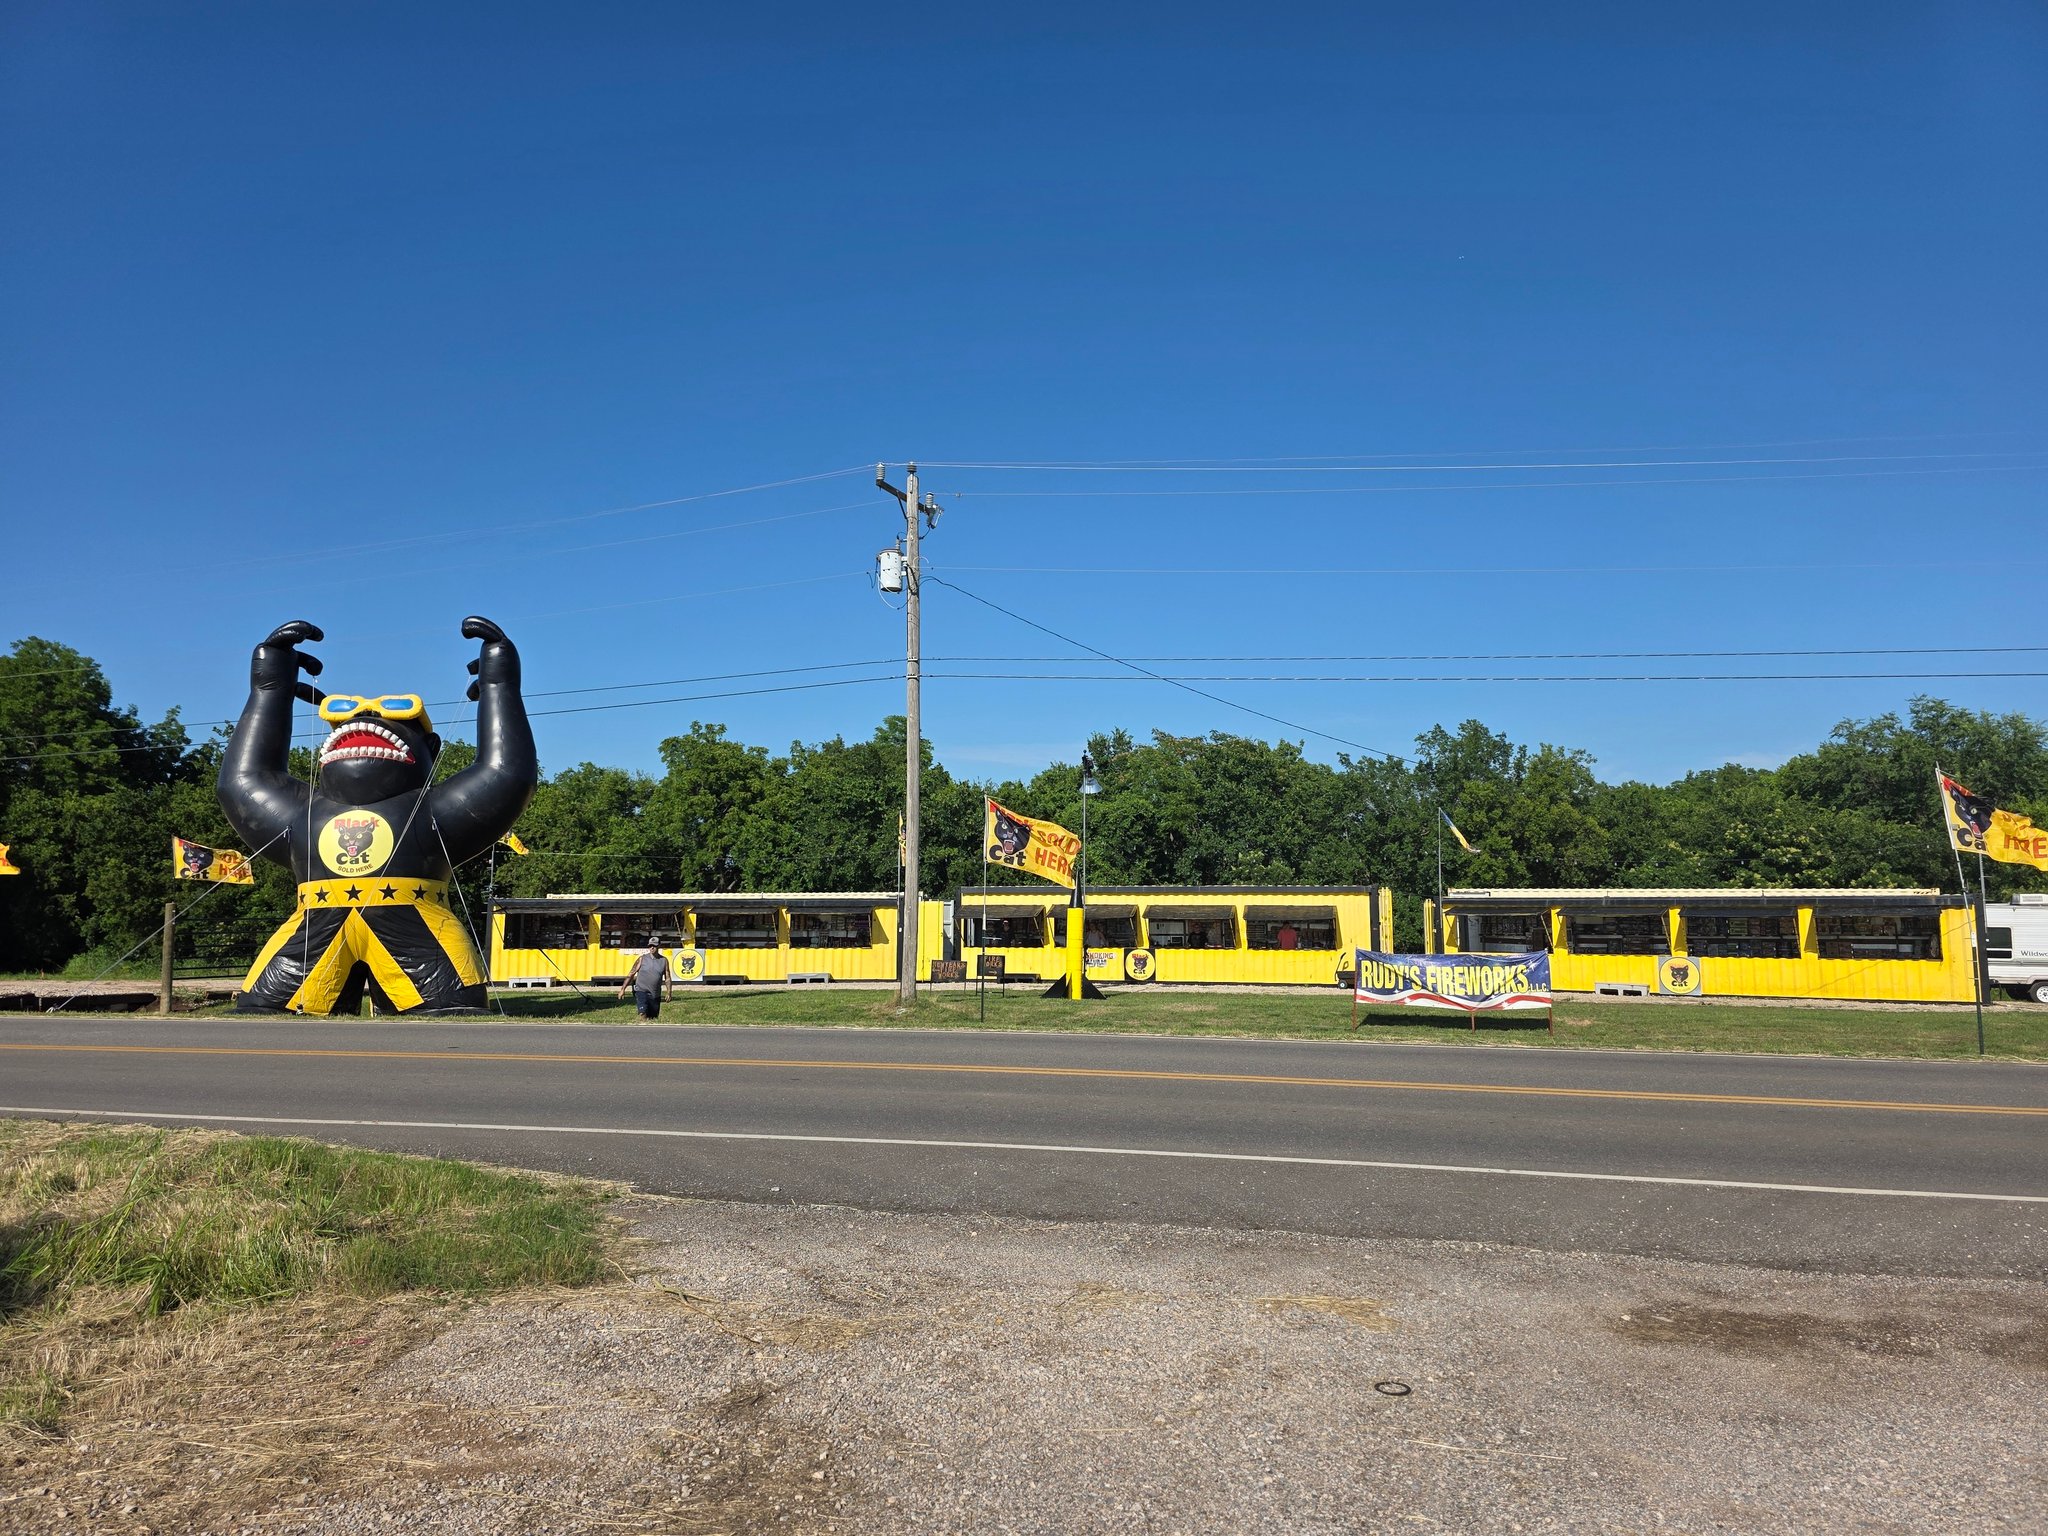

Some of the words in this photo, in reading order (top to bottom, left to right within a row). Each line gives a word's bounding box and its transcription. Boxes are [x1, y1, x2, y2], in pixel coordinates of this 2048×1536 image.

[1037, 830, 1081, 855] SOLD
[1957, 828, 1987, 851] Ca
[336, 852, 370, 866] Cat
[989, 845, 1027, 867] Cat
[338, 866, 355, 874] SOLD
[355, 864, 374, 873] HERE
[1361, 960, 1423, 991] RUDY'S
[1426, 964, 1529, 996] FIREWORKS
